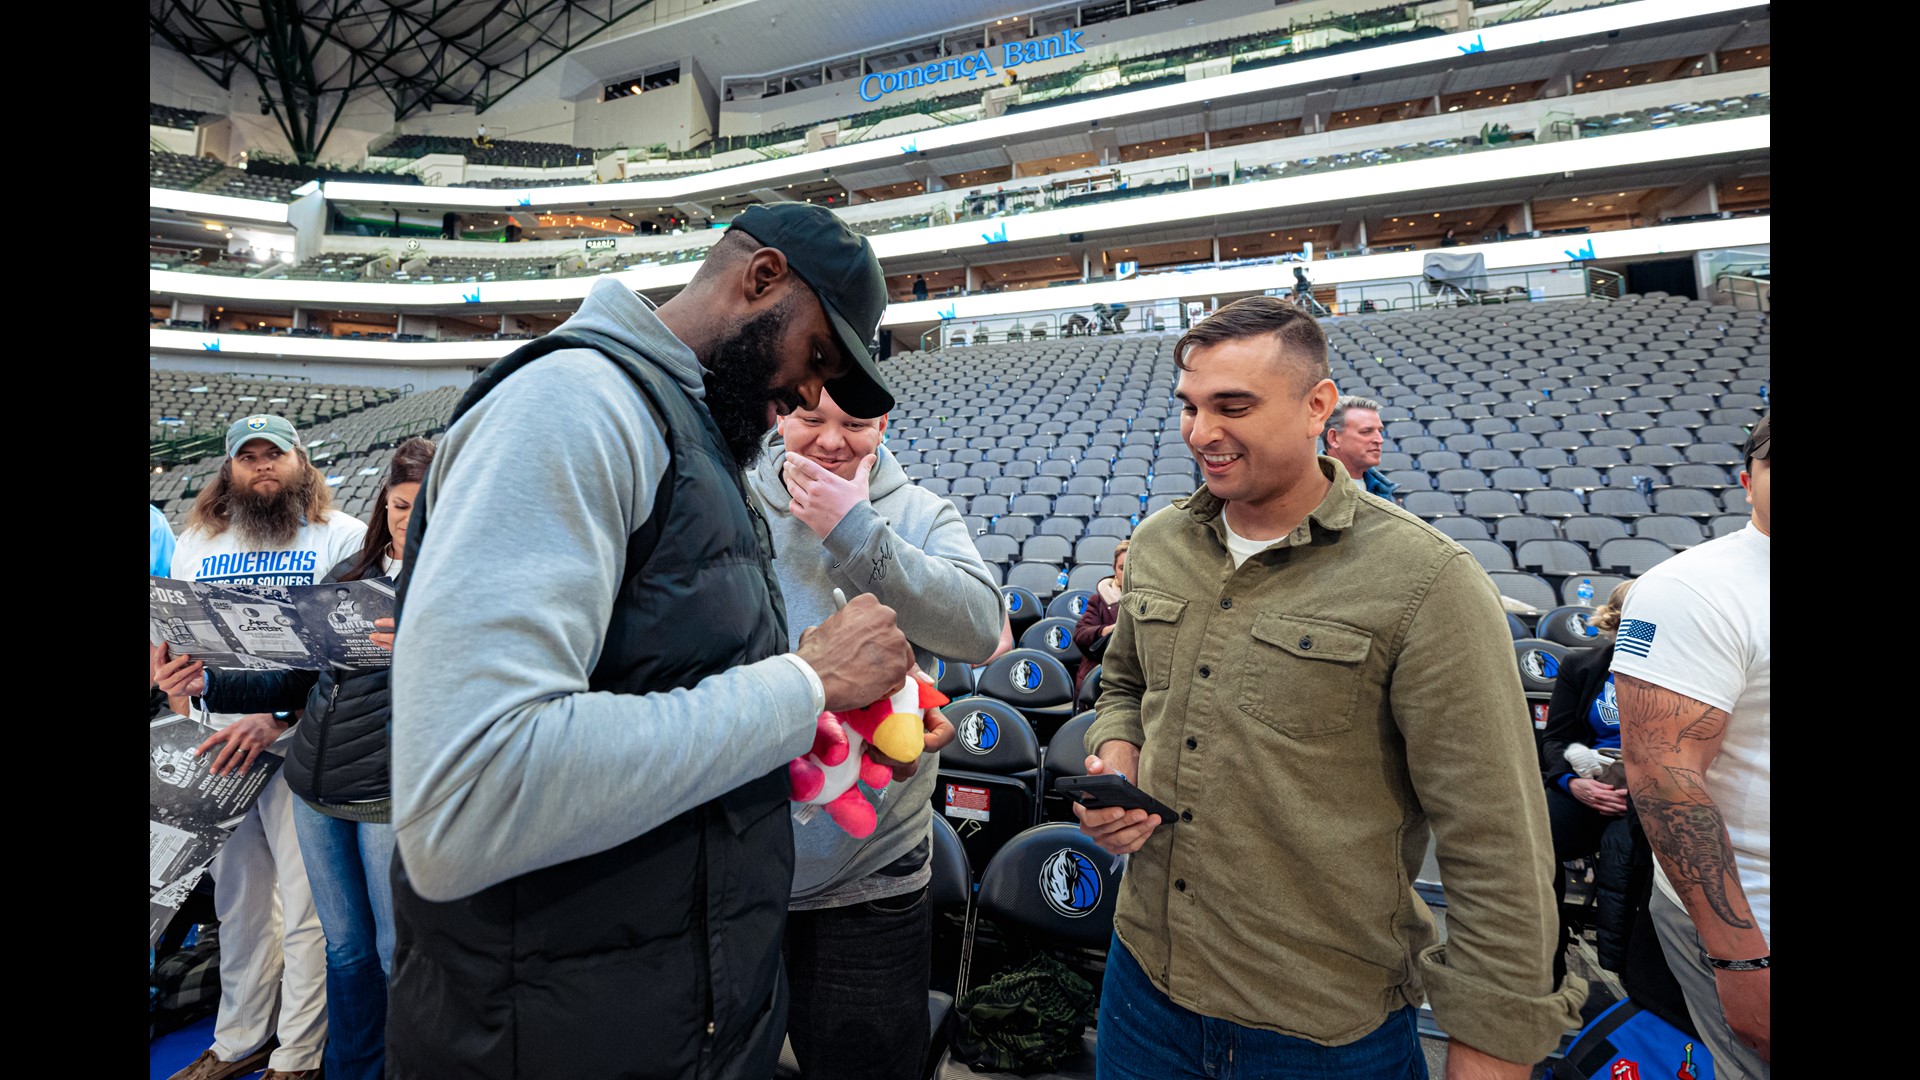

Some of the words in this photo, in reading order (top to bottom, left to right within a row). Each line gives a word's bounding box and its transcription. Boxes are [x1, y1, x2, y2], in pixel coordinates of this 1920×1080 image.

[1002, 28, 1085, 69] Bank
[196, 550, 317, 577] MAVERICKS
[331, 620, 376, 630] WINTER
[164, 747, 197, 785] WINTER
[177, 771, 194, 788] WARM
[189, 761, 198, 771] UP
[198, 774, 215, 791] DON
